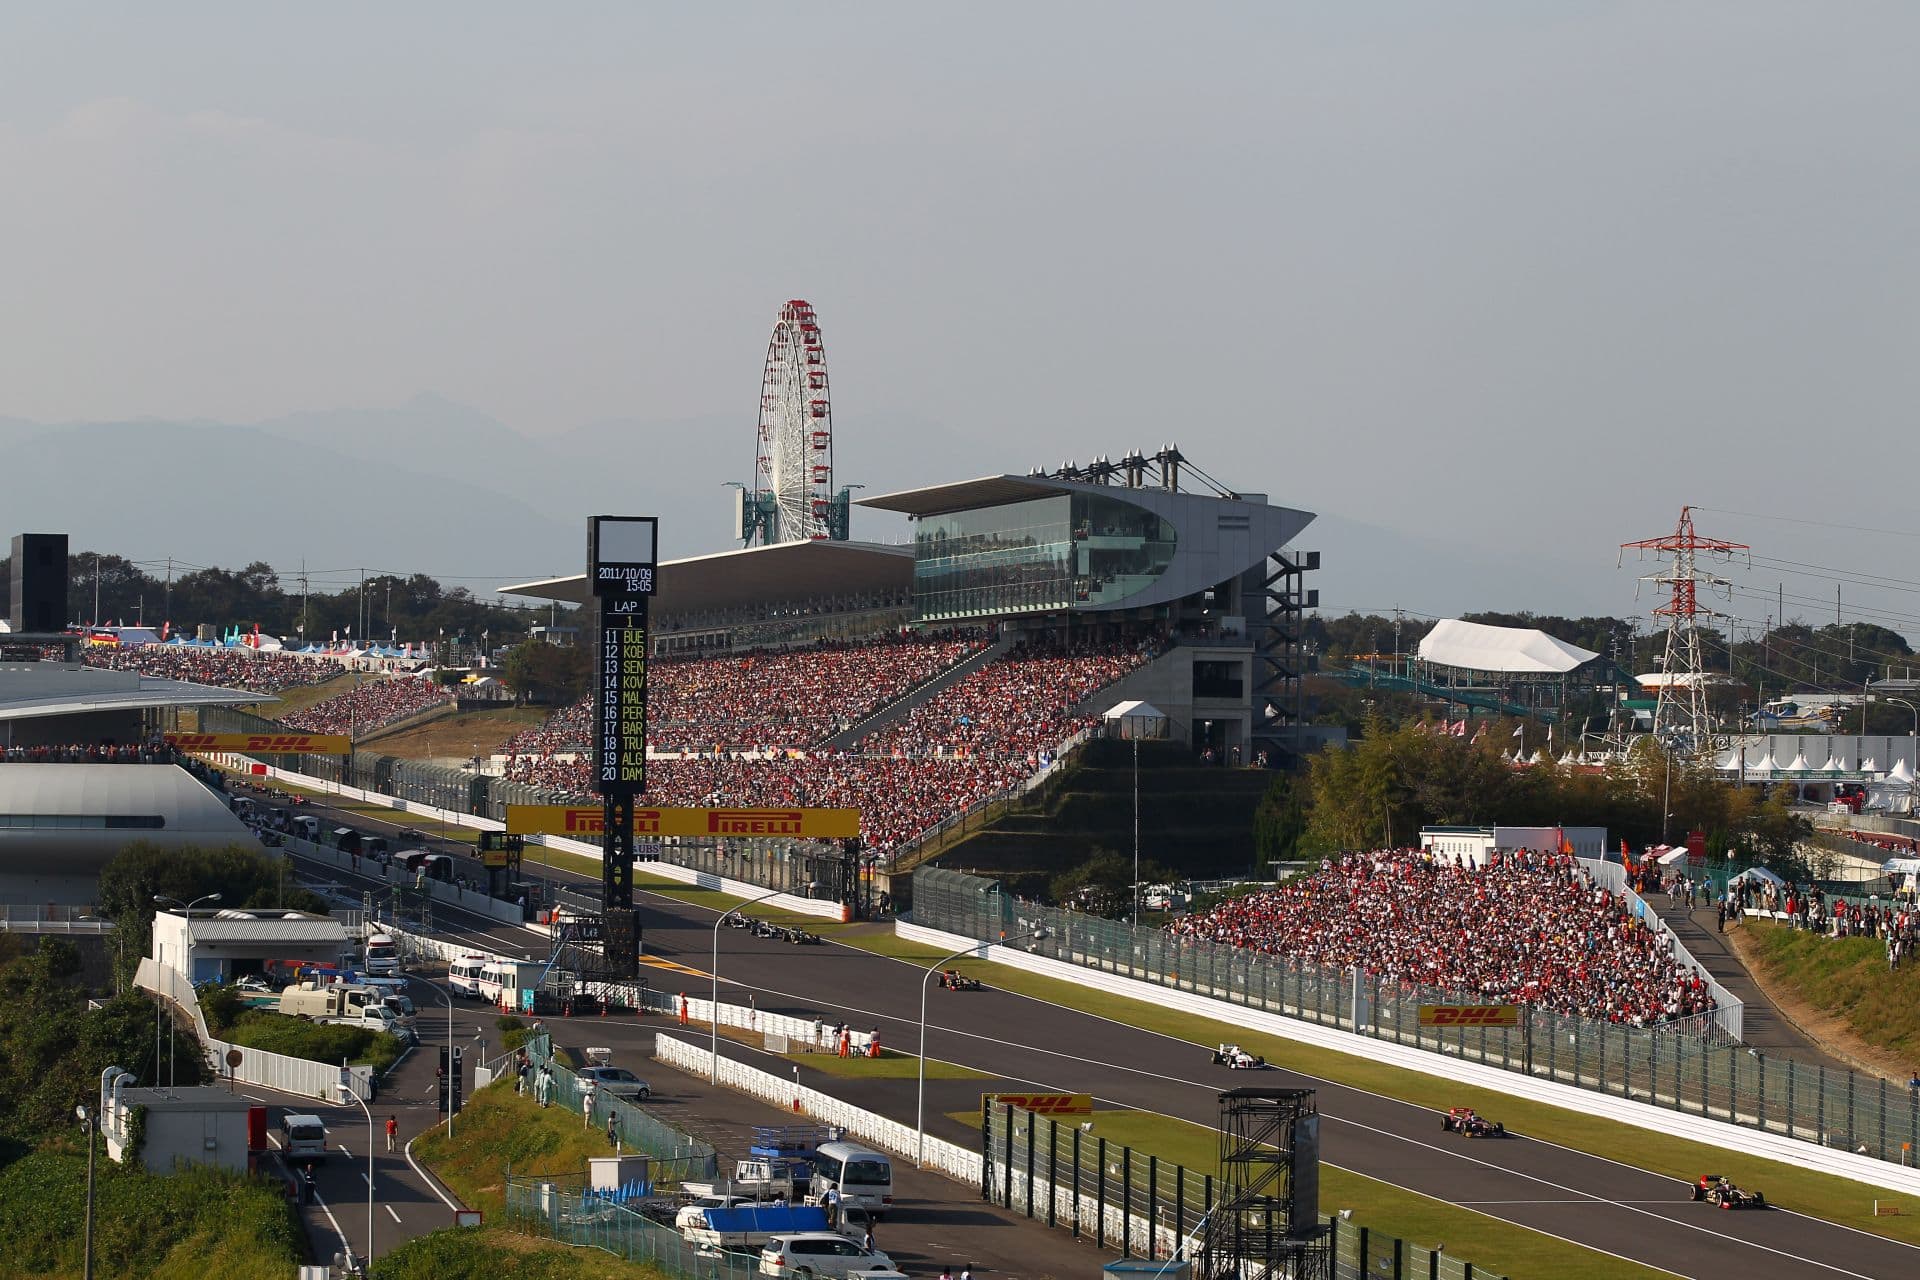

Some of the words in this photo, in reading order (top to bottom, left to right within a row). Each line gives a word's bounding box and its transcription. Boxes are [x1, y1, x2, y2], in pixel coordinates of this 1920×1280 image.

[599, 567, 652, 580] 2011/10/09
[626, 579, 652, 592] 15:05
[614, 601, 638, 612] LAP
[627, 615, 633, 628] 1
[605, 630, 618, 644] 11
[623, 630, 644, 644] BUE
[605, 645, 618, 659] 12
[623, 645, 644, 659] KOB
[605, 660, 618, 674] 13
[623, 660, 644, 674] SEN
[604, 675, 617, 689] 14
[623, 675, 643, 689] KOV
[604, 690, 617, 704] 15
[622, 690, 643, 704] MAL
[604, 706, 617, 719] 16
[622, 706, 643, 719] PER
[604, 721, 617, 735] 17
[622, 721, 643, 735] BAR
[246, 737, 314, 751] DHL
[603, 736, 617, 750] 18
[622, 736, 643, 750] TRU
[603, 751, 616, 765] 19
[622, 751, 643, 765] ALG
[602, 766, 616, 780] 20
[621, 766, 643, 780] DAM
[708, 812, 802, 833] PIRELLI
[639, 844, 659, 854] UBS
[1431, 1008, 1505, 1024] DHL
[453, 1045, 463, 1059] D
